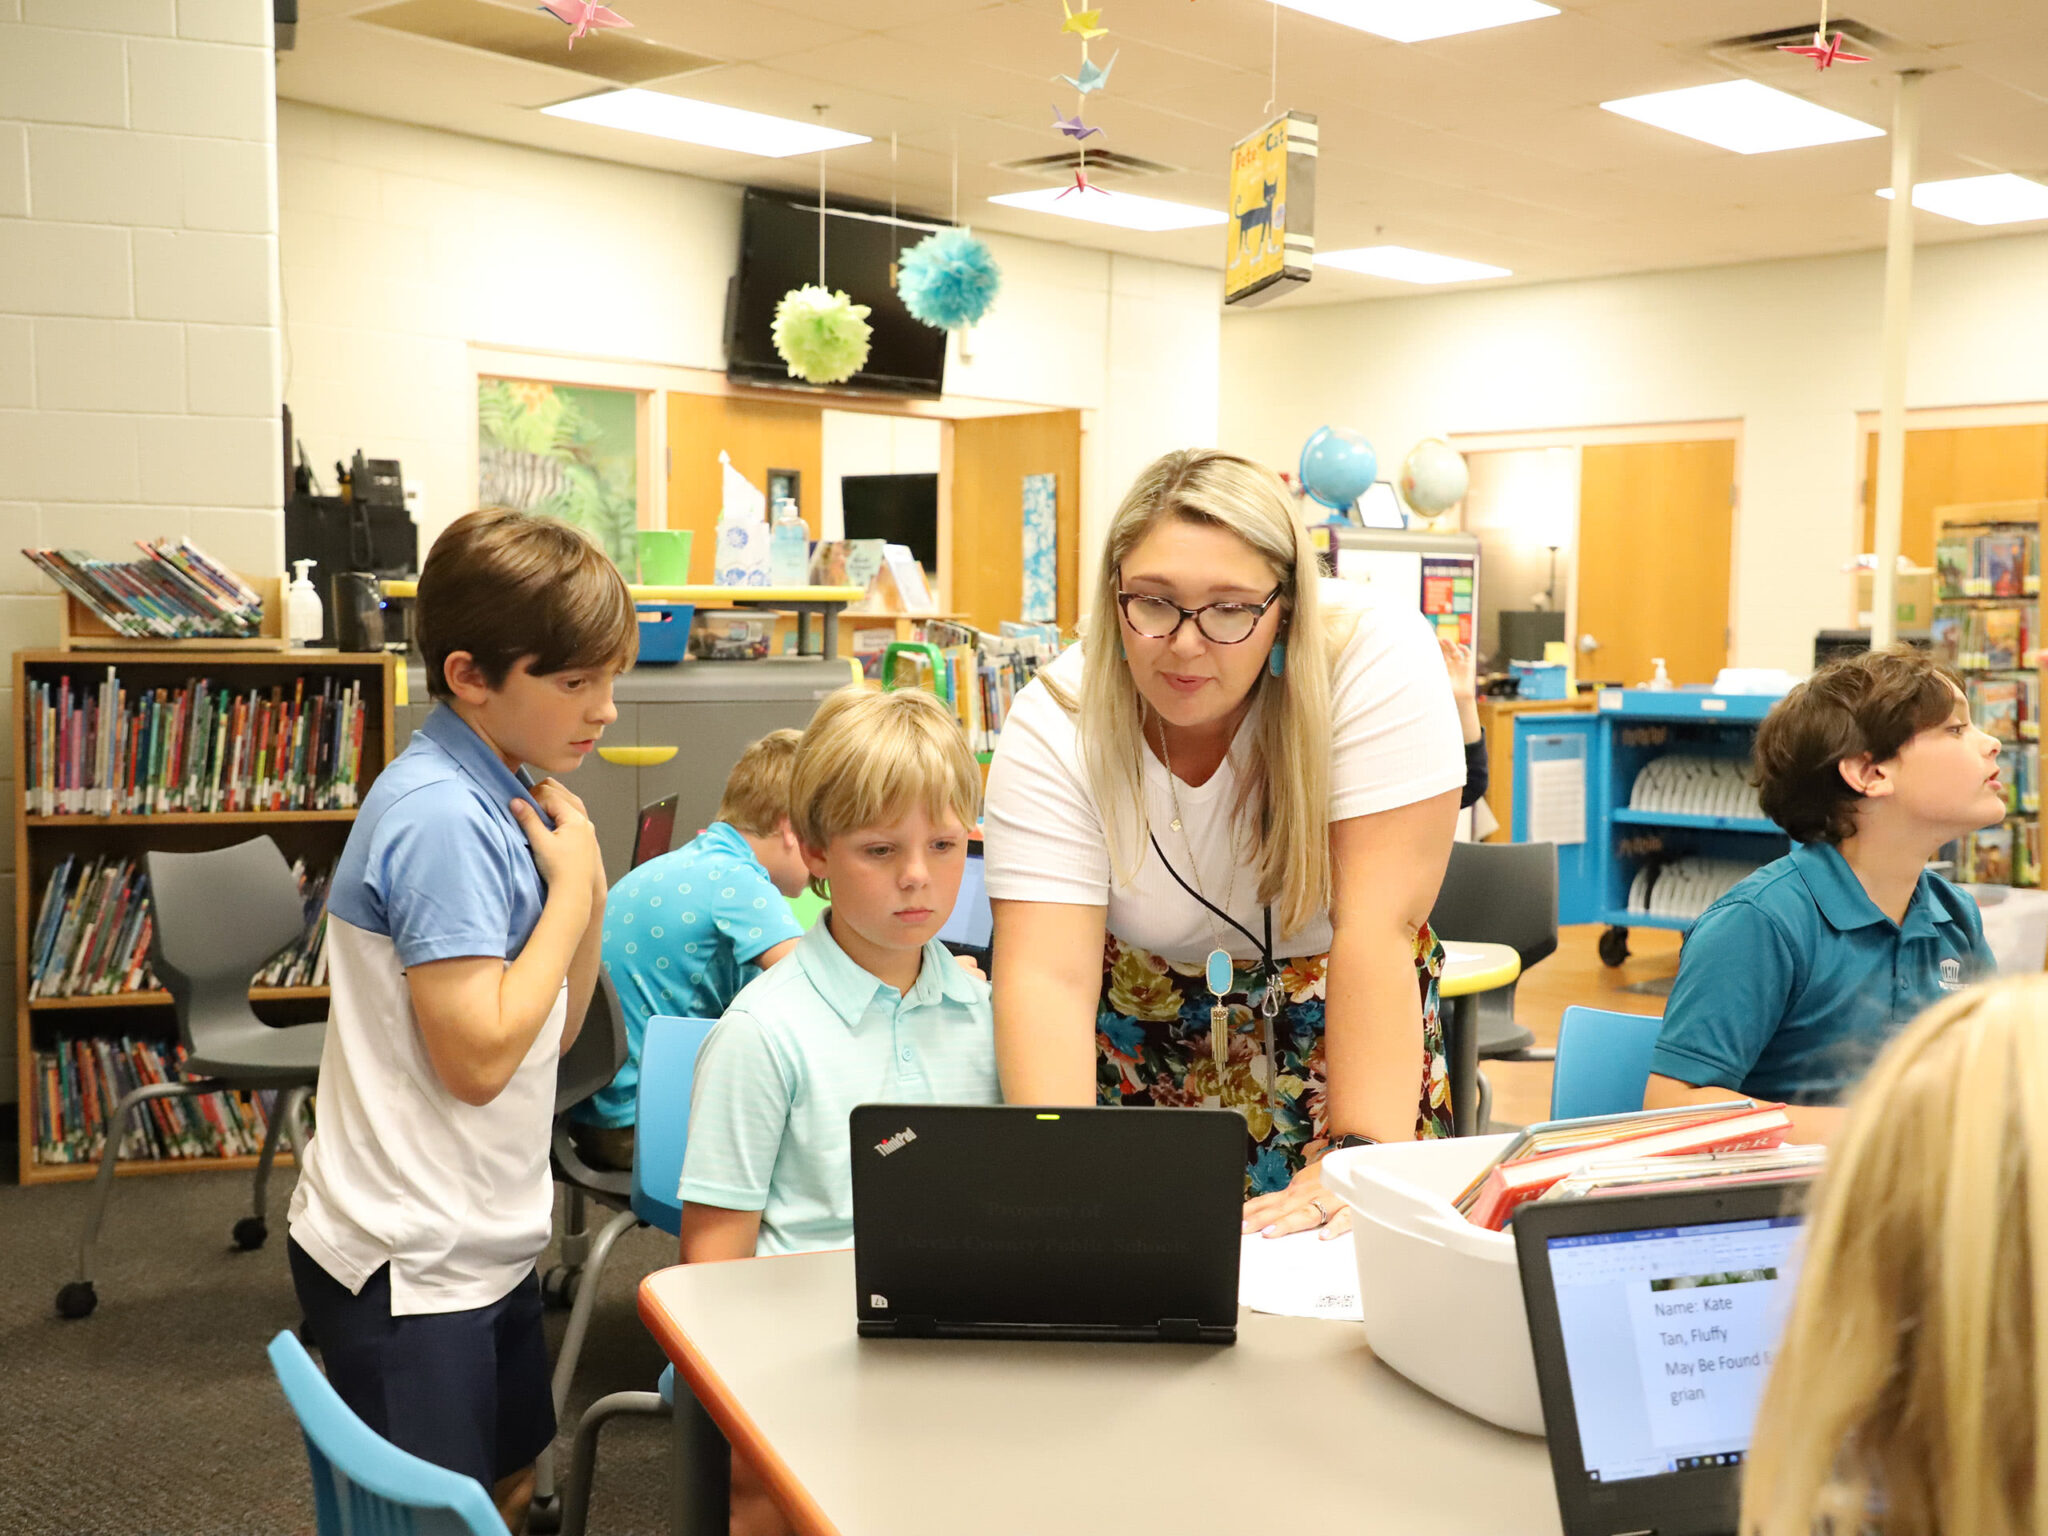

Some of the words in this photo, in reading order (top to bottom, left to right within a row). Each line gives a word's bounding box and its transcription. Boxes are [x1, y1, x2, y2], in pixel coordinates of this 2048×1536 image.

[1266, 128, 1284, 151] Cat
[874, 1126, 917, 1157] ThinkPad
[1655, 1302, 1699, 1316] Name:
[1703, 1298, 1733, 1312] Kate
[1659, 1332, 1688, 1347] Tan,
[1690, 1325, 1728, 1343] Fluffy
[1665, 1361, 1695, 1376] May
[1698, 1358, 1716, 1373] Be
[1718, 1353, 1760, 1370] Found
[1670, 1388, 1705, 1406] grian
